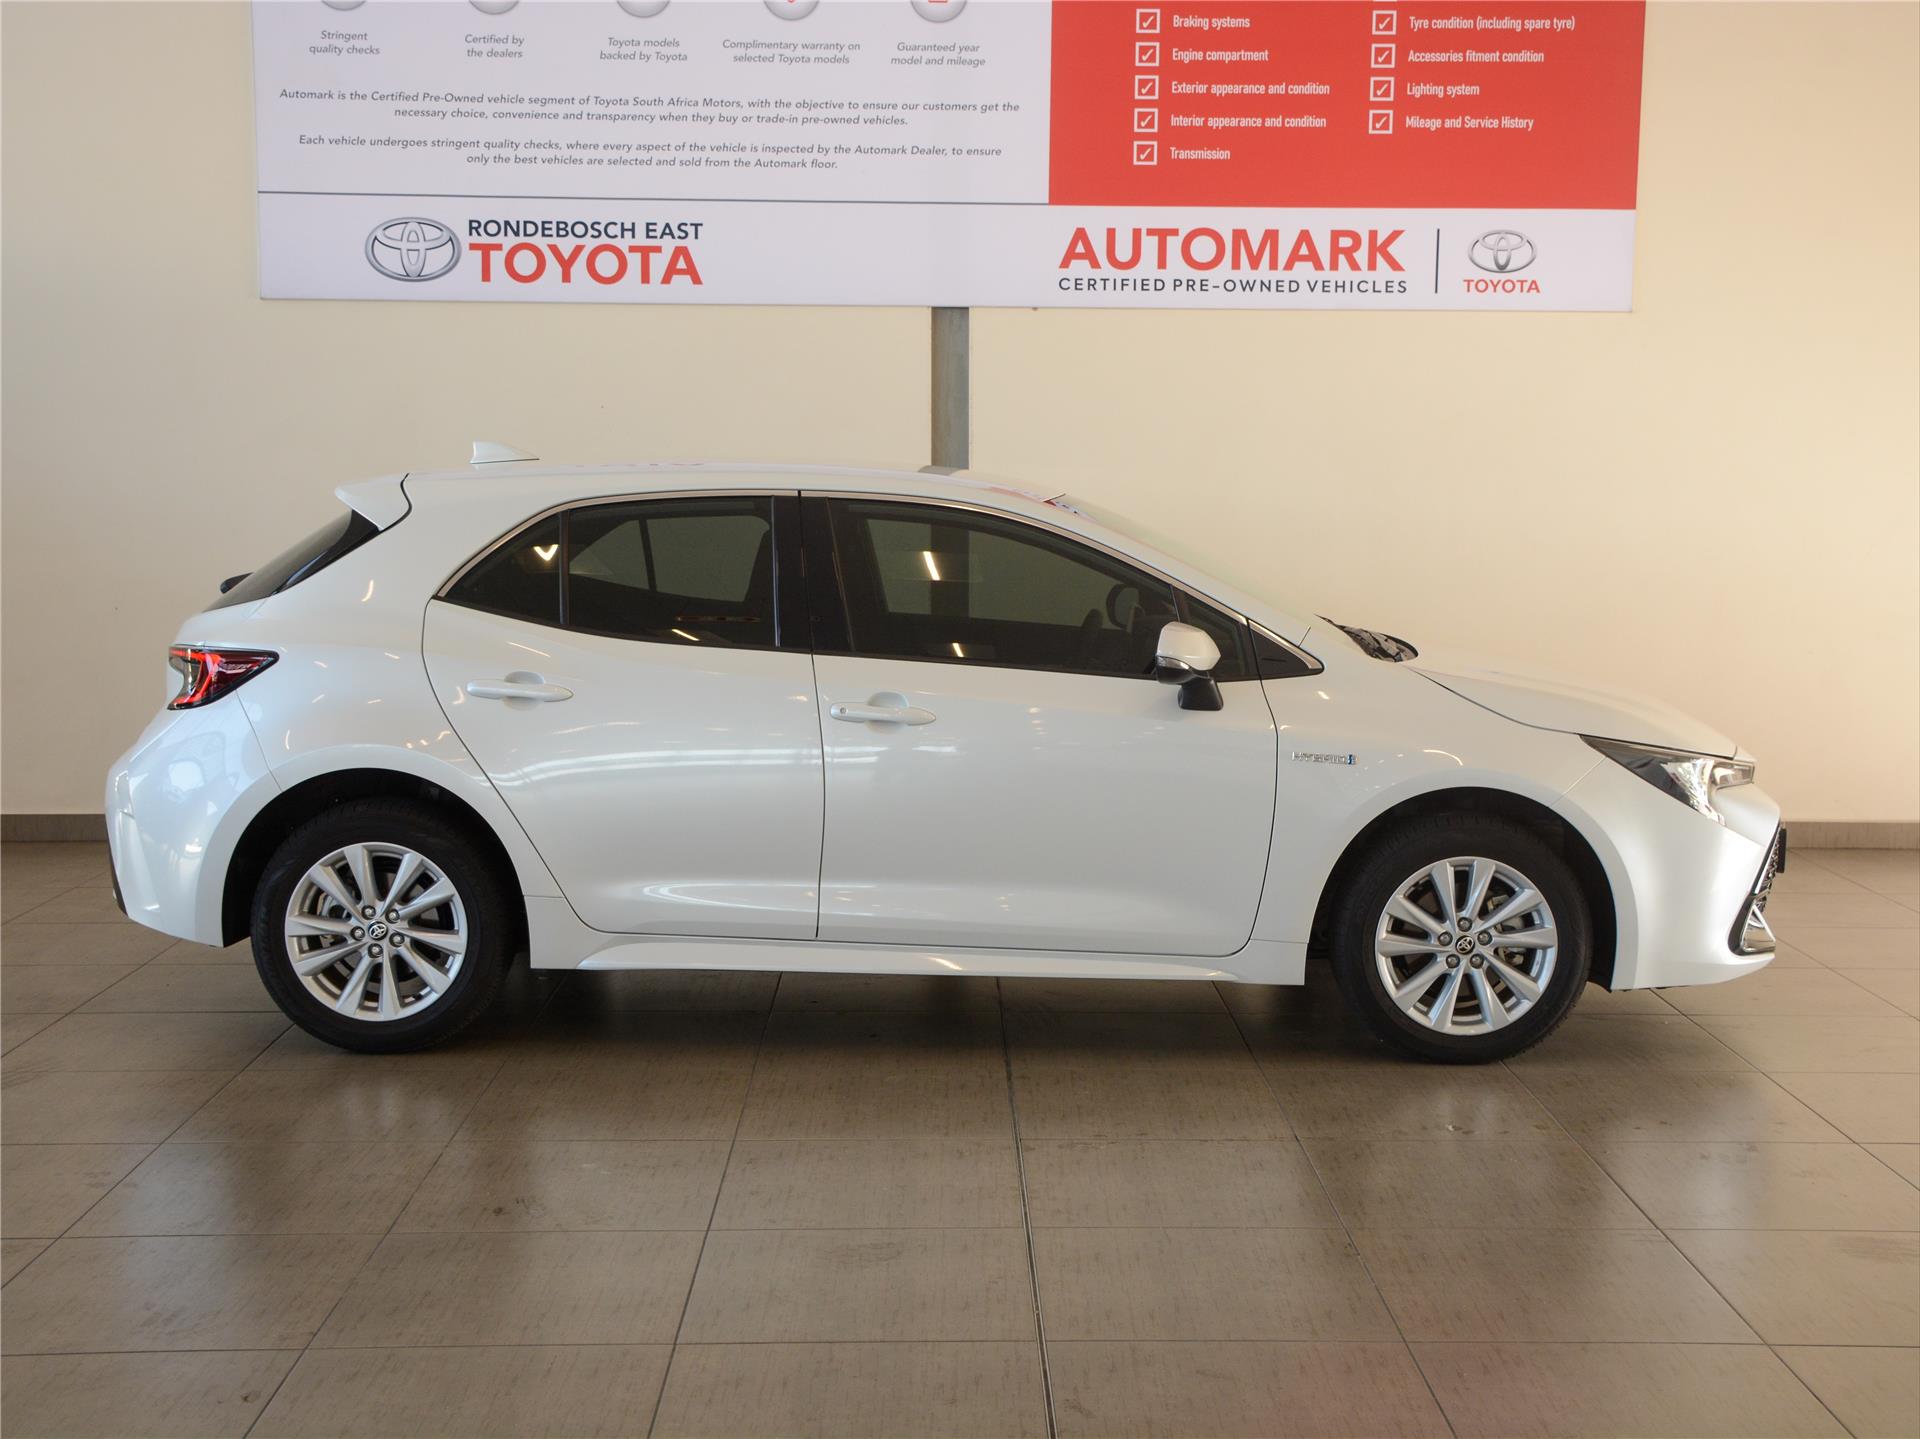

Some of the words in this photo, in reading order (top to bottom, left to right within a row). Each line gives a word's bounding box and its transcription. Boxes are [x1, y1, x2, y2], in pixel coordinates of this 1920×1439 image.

[1173, 14, 1209, 30] Braking
[1211, 16, 1250, 30] systems
[1409, 16, 1429, 31] Tyre
[1431, 16, 1474, 29] condition
[1476, 15, 1521, 32] (including
[1523, 18, 1550, 32] spare
[1553, 15, 1575, 32] tyre)
[320, 30, 367, 43] Stringent
[464, 33, 509, 44] Certified
[511, 34, 524, 47] by
[607, 37, 640, 49] Toyota
[643, 37, 680, 47] models
[308, 43, 343, 56] quality
[346, 44, 380, 54] checks
[466, 47, 483, 57] the
[486, 47, 523, 58] dealers
[722, 39, 798, 52] Complimentary
[801, 42, 845, 53] warranty
[896, 41, 956, 52] Guaranteed
[957, 45, 980, 55] year
[599, 50, 636, 60] backed
[638, 50, 652, 62] by
[655, 51, 687, 63] Toyota
[733, 52, 775, 63] selected
[778, 53, 810, 65] Toyota
[813, 54, 849, 64] models
[890, 55, 922, 64] model
[924, 55, 944, 65] and
[946, 55, 986, 68] mileage
[1172, 48, 1203, 63] Engine
[1205, 49, 1268, 64] compartment
[1407, 49, 1463, 62] Accessories
[1465, 49, 1500, 62] fitment
[1501, 49, 1544, 62] condition
[1171, 80, 1208, 94] Exterior
[1210, 84, 1265, 97] appearance
[1267, 82, 1285, 94] and
[1287, 82, 1330, 94] condition
[1406, 82, 1444, 98] Lighting
[1446, 83, 1480, 98] system
[279, 88, 333, 99] Automark
[337, 90, 346, 100] is
[349, 90, 367, 100] the
[370, 90, 419, 101] Certified
[422, 92, 484, 103] Pre-Owned
[487, 93, 525, 103] vehicle
[527, 96, 575, 107] segment
[578, 95, 590, 105] of
[593, 95, 629, 108] Toyota
[632, 96, 664, 106] South
[666, 96, 698, 107] Africa
[702, 97, 743, 108] Motors,
[747, 98, 770, 108] with
[774, 98, 791, 108] the
[795, 99, 844, 112] objective
[848, 101, 859, 109] to
[862, 102, 898, 110] ensure
[922, 102, 977, 111] customers
[980, 103, 998, 114] get
[1002, 101, 1019, 111] the
[394, 109, 448, 119] necessary
[450, 107, 488, 119] choice,
[492, 109, 559, 119] convenience
[562, 110, 583, 119] and
[586, 112, 656, 123] transparency
[659, 111, 687, 121] when
[691, 112, 715, 124] they
[718, 112, 738, 125] buy
[756, 113, 798, 123] trade-in
[801, 113, 860, 126] pre-owned
[863, 114, 907, 125] vehicles.
[1170, 114, 1205, 126] Interior
[1207, 117, 1262, 130] appearance
[1264, 114, 1282, 127] and
[1284, 114, 1326, 127] condition
[1405, 115, 1442, 131] Mileage
[1444, 115, 1462, 128] and
[1464, 115, 1499, 128] Service
[1501, 116, 1533, 131] History
[299, 134, 324, 144] Each
[328, 135, 366, 145] vehicle
[369, 135, 428, 149] undergoes
[431, 137, 480, 150] stringent
[483, 138, 520, 151] quality
[523, 139, 561, 150] checks,
[566, 140, 599, 150] where
[602, 143, 632, 153] every
[635, 143, 671, 153] aspect
[674, 141, 686, 151] of
[689, 142, 706, 151] the
[709, 142, 746, 152] vehicle
[750, 143, 758, 152] is
[761, 143, 814, 155] inspected
[817, 144, 830, 156] by
[834, 144, 851, 154] the
[854, 144, 907, 155] Automark
[910, 145, 947, 156] Dealer,
[951, 147, 963, 155] to
[966, 148, 1001, 156] ensure
[1169, 146, 1230, 159] Transmission
[466, 153, 489, 166] only
[493, 153, 510, 163] the
[514, 153, 537, 164] best
[540, 154, 583, 165] vehicles
[607, 155, 652, 166] selected
[655, 156, 676, 166] and
[679, 156, 701, 166] sold
[704, 156, 730, 167] from
[733, 157, 750, 167] the
[753, 157, 807, 168] Automark
[810, 158, 837, 168] floor.
[468, 219, 635, 239] RONDEBOSCH
[645, 222, 703, 240] EAST
[1058, 227, 1405, 272] AUTOMARK
[468, 243, 703, 286] TOYOTA
[1058, 277, 1165, 291] CERTIFIED
[1173, 278, 1299, 293] PRE-OWNED
[1306, 279, 1406, 293] VEHICLES
[1463, 278, 1540, 293] TOYOTA
